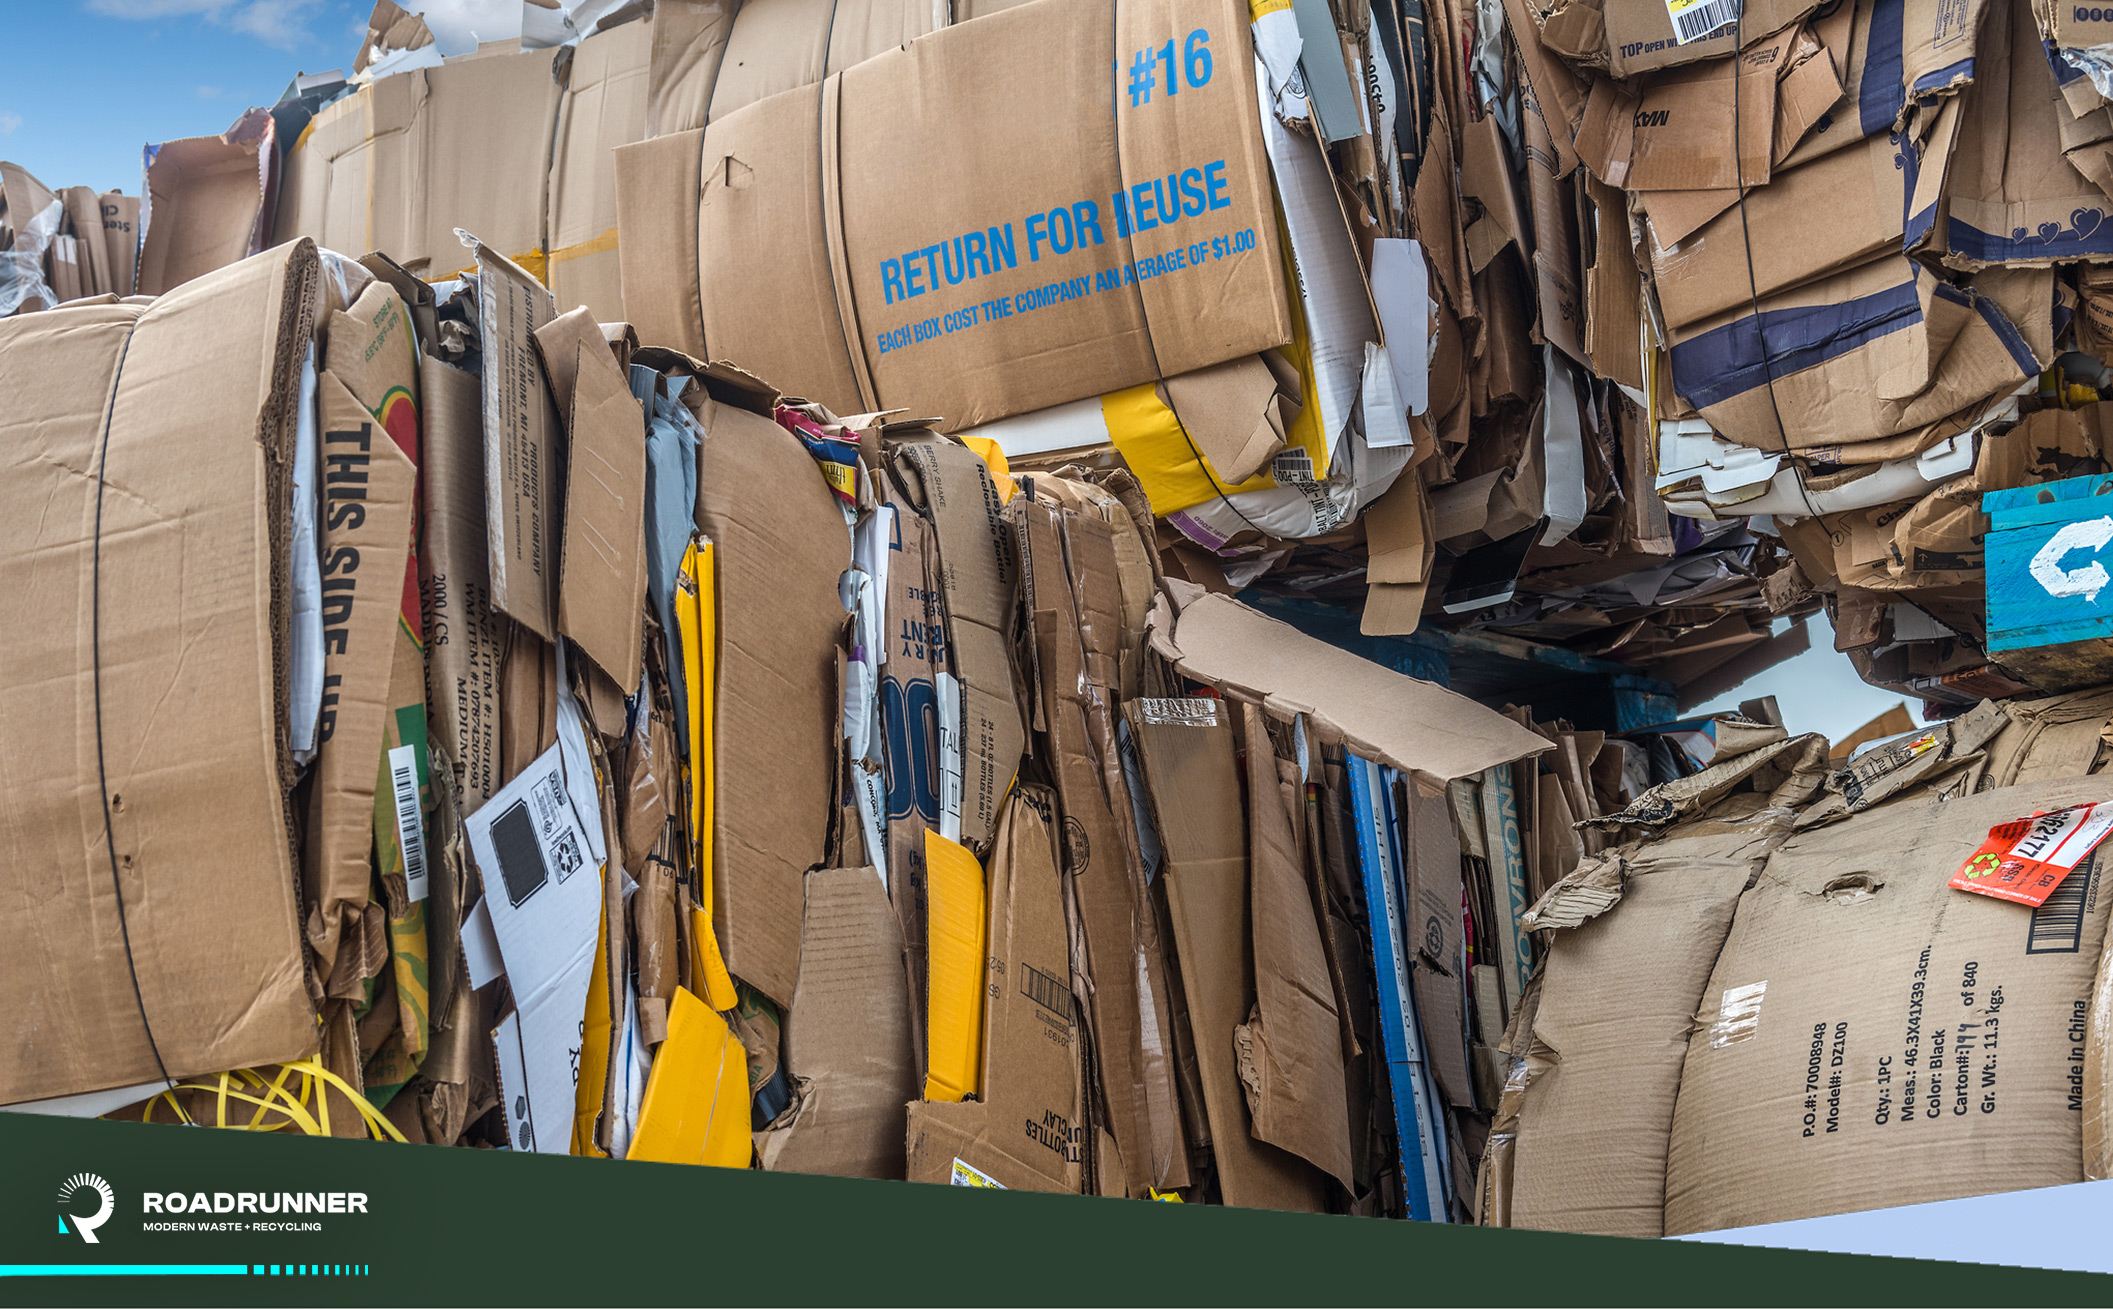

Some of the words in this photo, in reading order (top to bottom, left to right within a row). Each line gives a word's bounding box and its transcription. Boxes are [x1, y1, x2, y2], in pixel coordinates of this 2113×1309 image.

[1620, 42, 1643, 58] TOP
[1645, 40, 1664, 53] OPEN
[1709, 28, 1724, 39] END
[1727, 25, 1737, 36] UP
[1128, 28, 1213, 108] #16
[880, 223, 1018, 304] RETURN
[1025, 201, 1104, 262] FOR
[877, 324, 911, 354] EACH
[913, 317, 942, 343] BOX
[944, 306, 979, 333] COST
[981, 296, 1012, 322] THE
[1015, 275, 1091, 314] COMPANY
[1095, 268, 1120, 292] AN
[1124, 249, 1186, 285] AERAGE
[1189, 241, 1208, 265] OF
[1212, 228, 1255, 260] $1.00
[518, 346, 528, 409] FREMONT,
[528, 369, 536, 387] BY
[519, 412, 528, 431] MI
[325, 422, 371, 532] THIS
[522, 473, 530, 498] USA
[530, 442, 538, 510] PRODUCTS
[924, 443, 938, 475] BERRY
[933, 475, 947, 509] SHAKE
[531, 512, 541, 576] COMPANY
[976, 462, 999, 537] Reclosable
[992, 538, 1008, 585] Bottle!
[322, 546, 360, 656] SIDE
[432, 574, 447, 609] 2000
[466, 582, 475, 617] WM
[434, 622, 448, 646] CS
[468, 621, 478, 666] ITEM
[470, 671, 478, 686] #:
[482, 651, 492, 697] ITEM
[457, 677, 468, 759] MEDIUM
[981, 717, 987, 727] 24
[987, 721, 994, 731] 24
[470, 690, 481, 789] 07874207693
[481, 723, 493, 800] H5010004
[979, 759, 987, 791] BOTTLES
[2038, 874, 2055, 887] CB
[1962, 961, 1978, 988] 840
[1905, 945, 1931, 1067] 46.3X41X39.3cm.
[1961, 992, 1975, 1006] of
[1985, 985, 2004, 1014] kgs.
[1984, 1017, 1999, 1049] 11.3
[2068, 1000, 2086, 1042] China
[1831, 1021, 1848, 1067] DZ100
[1930, 1028, 1946, 1069] Black
[2068, 1047, 2083, 1061] in
[1879, 1055, 1892, 1085] 1PC
[1982, 1054, 1997, 1088] Wt.:
[2067, 1065, 2082, 1111] Made
[1826, 1070, 1842, 1133] Model#:
[1875, 1088, 1892, 1125] Qty.:
[1901, 1071, 1917, 1122] Meas.:
[1927, 1073, 1942, 1119] Color:
[1981, 1092, 1995, 1114] Gr.
[1042, 1109, 1067, 1136] CLAY
